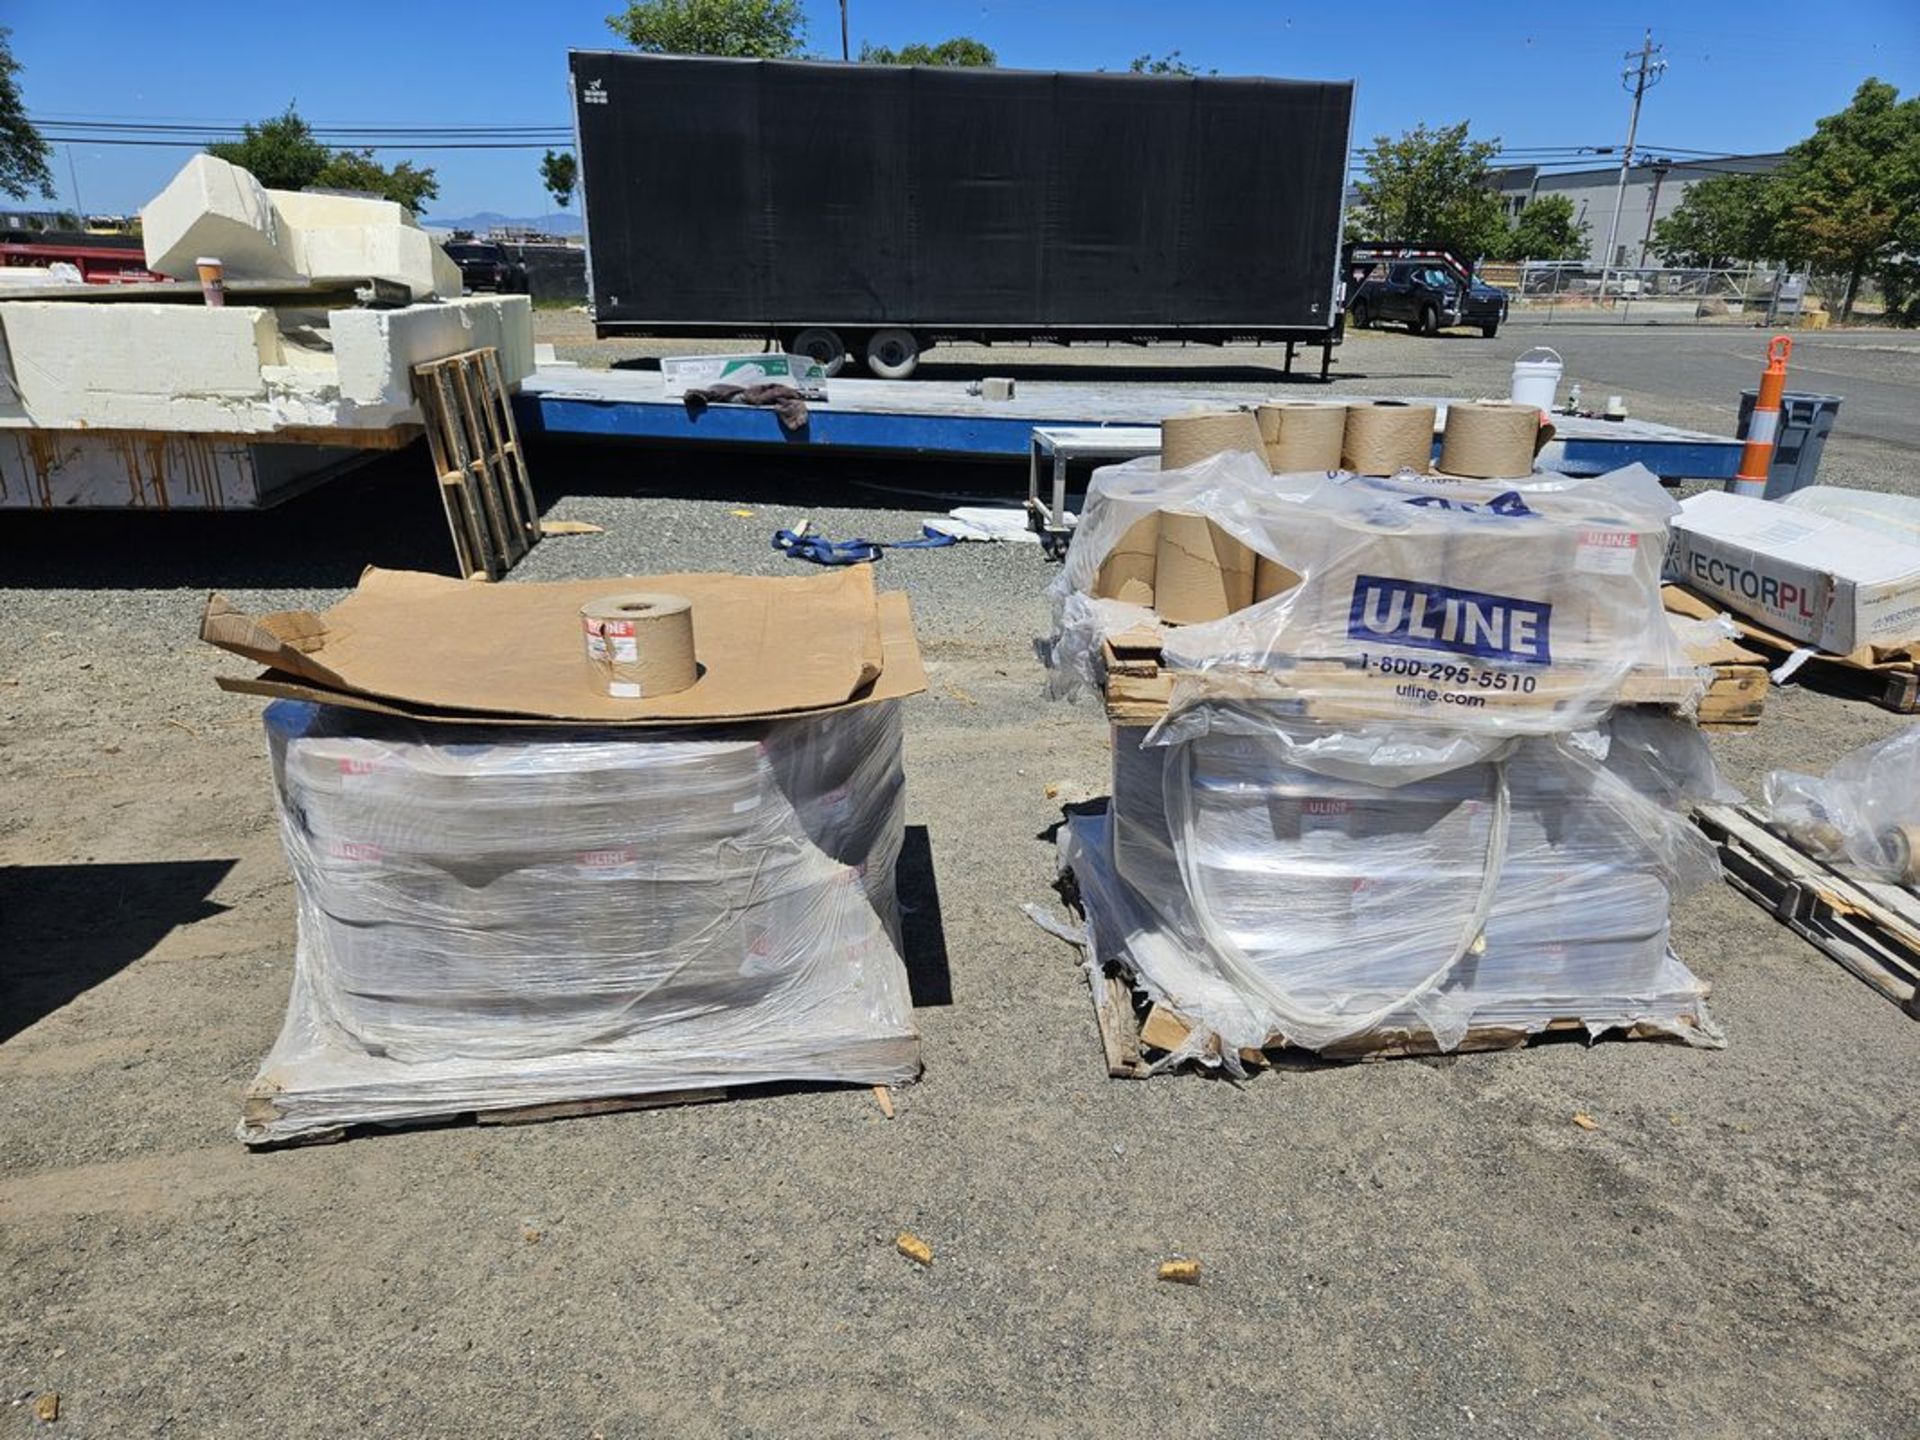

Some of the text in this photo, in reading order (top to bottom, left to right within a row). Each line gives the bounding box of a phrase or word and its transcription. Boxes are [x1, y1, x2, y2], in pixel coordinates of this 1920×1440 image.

[1587, 530, 1631, 546] ULINE
[1363, 587, 1539, 655] ULINE
[1360, 652, 1537, 694] 1-800-295-5510
[1396, 683, 1487, 708] uline.com
